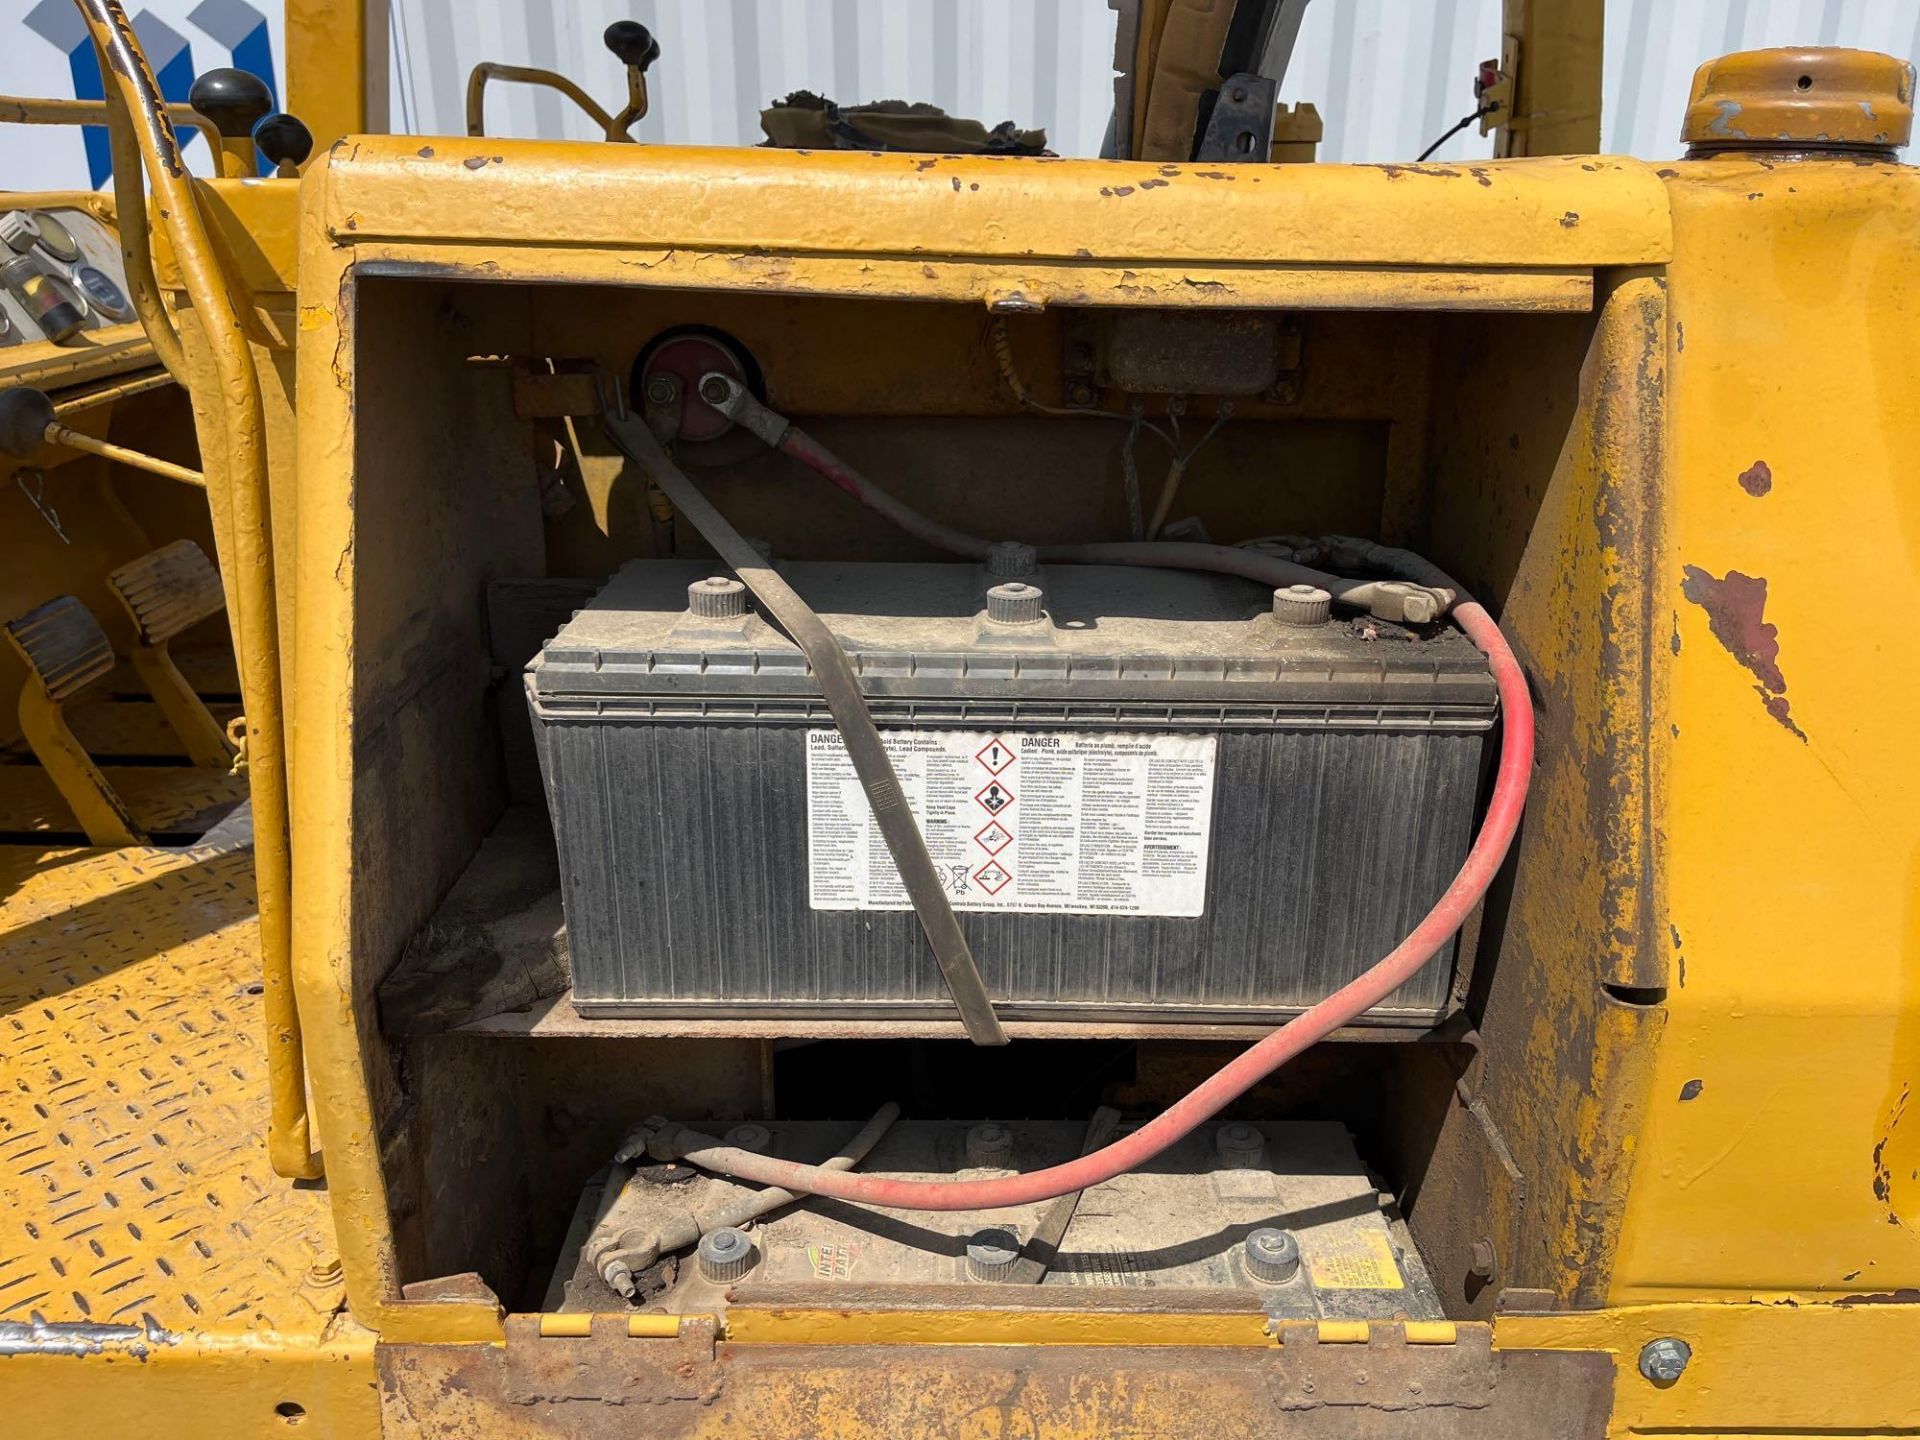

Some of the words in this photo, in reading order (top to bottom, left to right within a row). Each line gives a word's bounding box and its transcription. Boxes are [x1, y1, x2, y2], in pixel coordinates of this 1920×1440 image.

[811, 734, 843, 743] DANGE
[893, 738, 912, 746] Battery
[1021, 737, 1060, 748] DANGER
